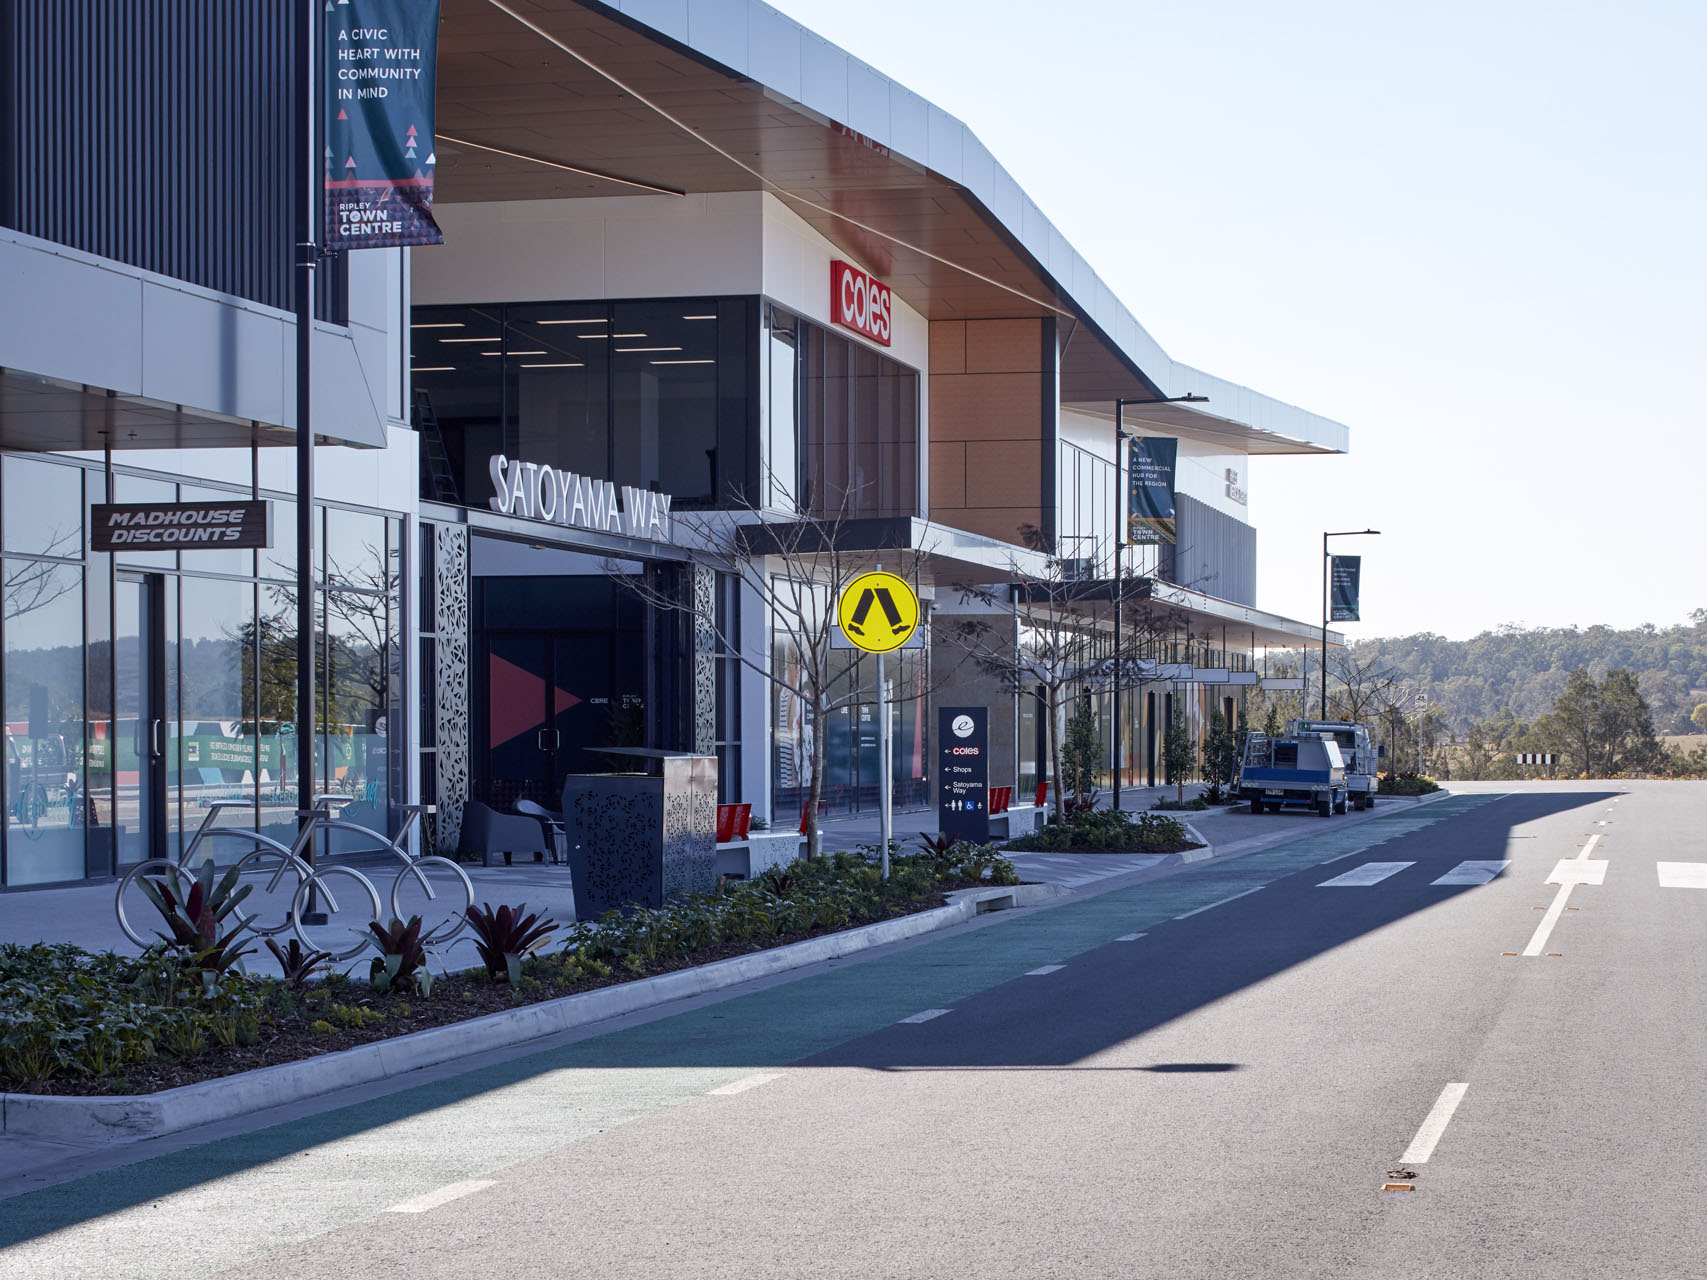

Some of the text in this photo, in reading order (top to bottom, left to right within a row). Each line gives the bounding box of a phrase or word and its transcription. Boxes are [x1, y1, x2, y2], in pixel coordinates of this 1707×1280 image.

[338, 28, 388, 41] A CIVIC
[338, 48, 420, 61] HEART WITH
[338, 67, 421, 80] COMMUNITY
[338, 87, 388, 100] IN MIND
[339, 202, 371, 211] RIPLEY
[339, 210, 388, 223] TOWN
[339, 221, 402, 236] CENTRE
[842, 268, 890, 340] coles
[1132, 464, 1172, 472] COMMERCIAL
[489, 454, 672, 542] SATOYAMA WAY
[108, 509, 246, 527] MADHOUSE
[110, 527, 242, 544] DISCOUNTS
[952, 747, 979, 755] coles
[952, 781, 983, 789] Satoyama
[952, 787, 967, 795] Way
